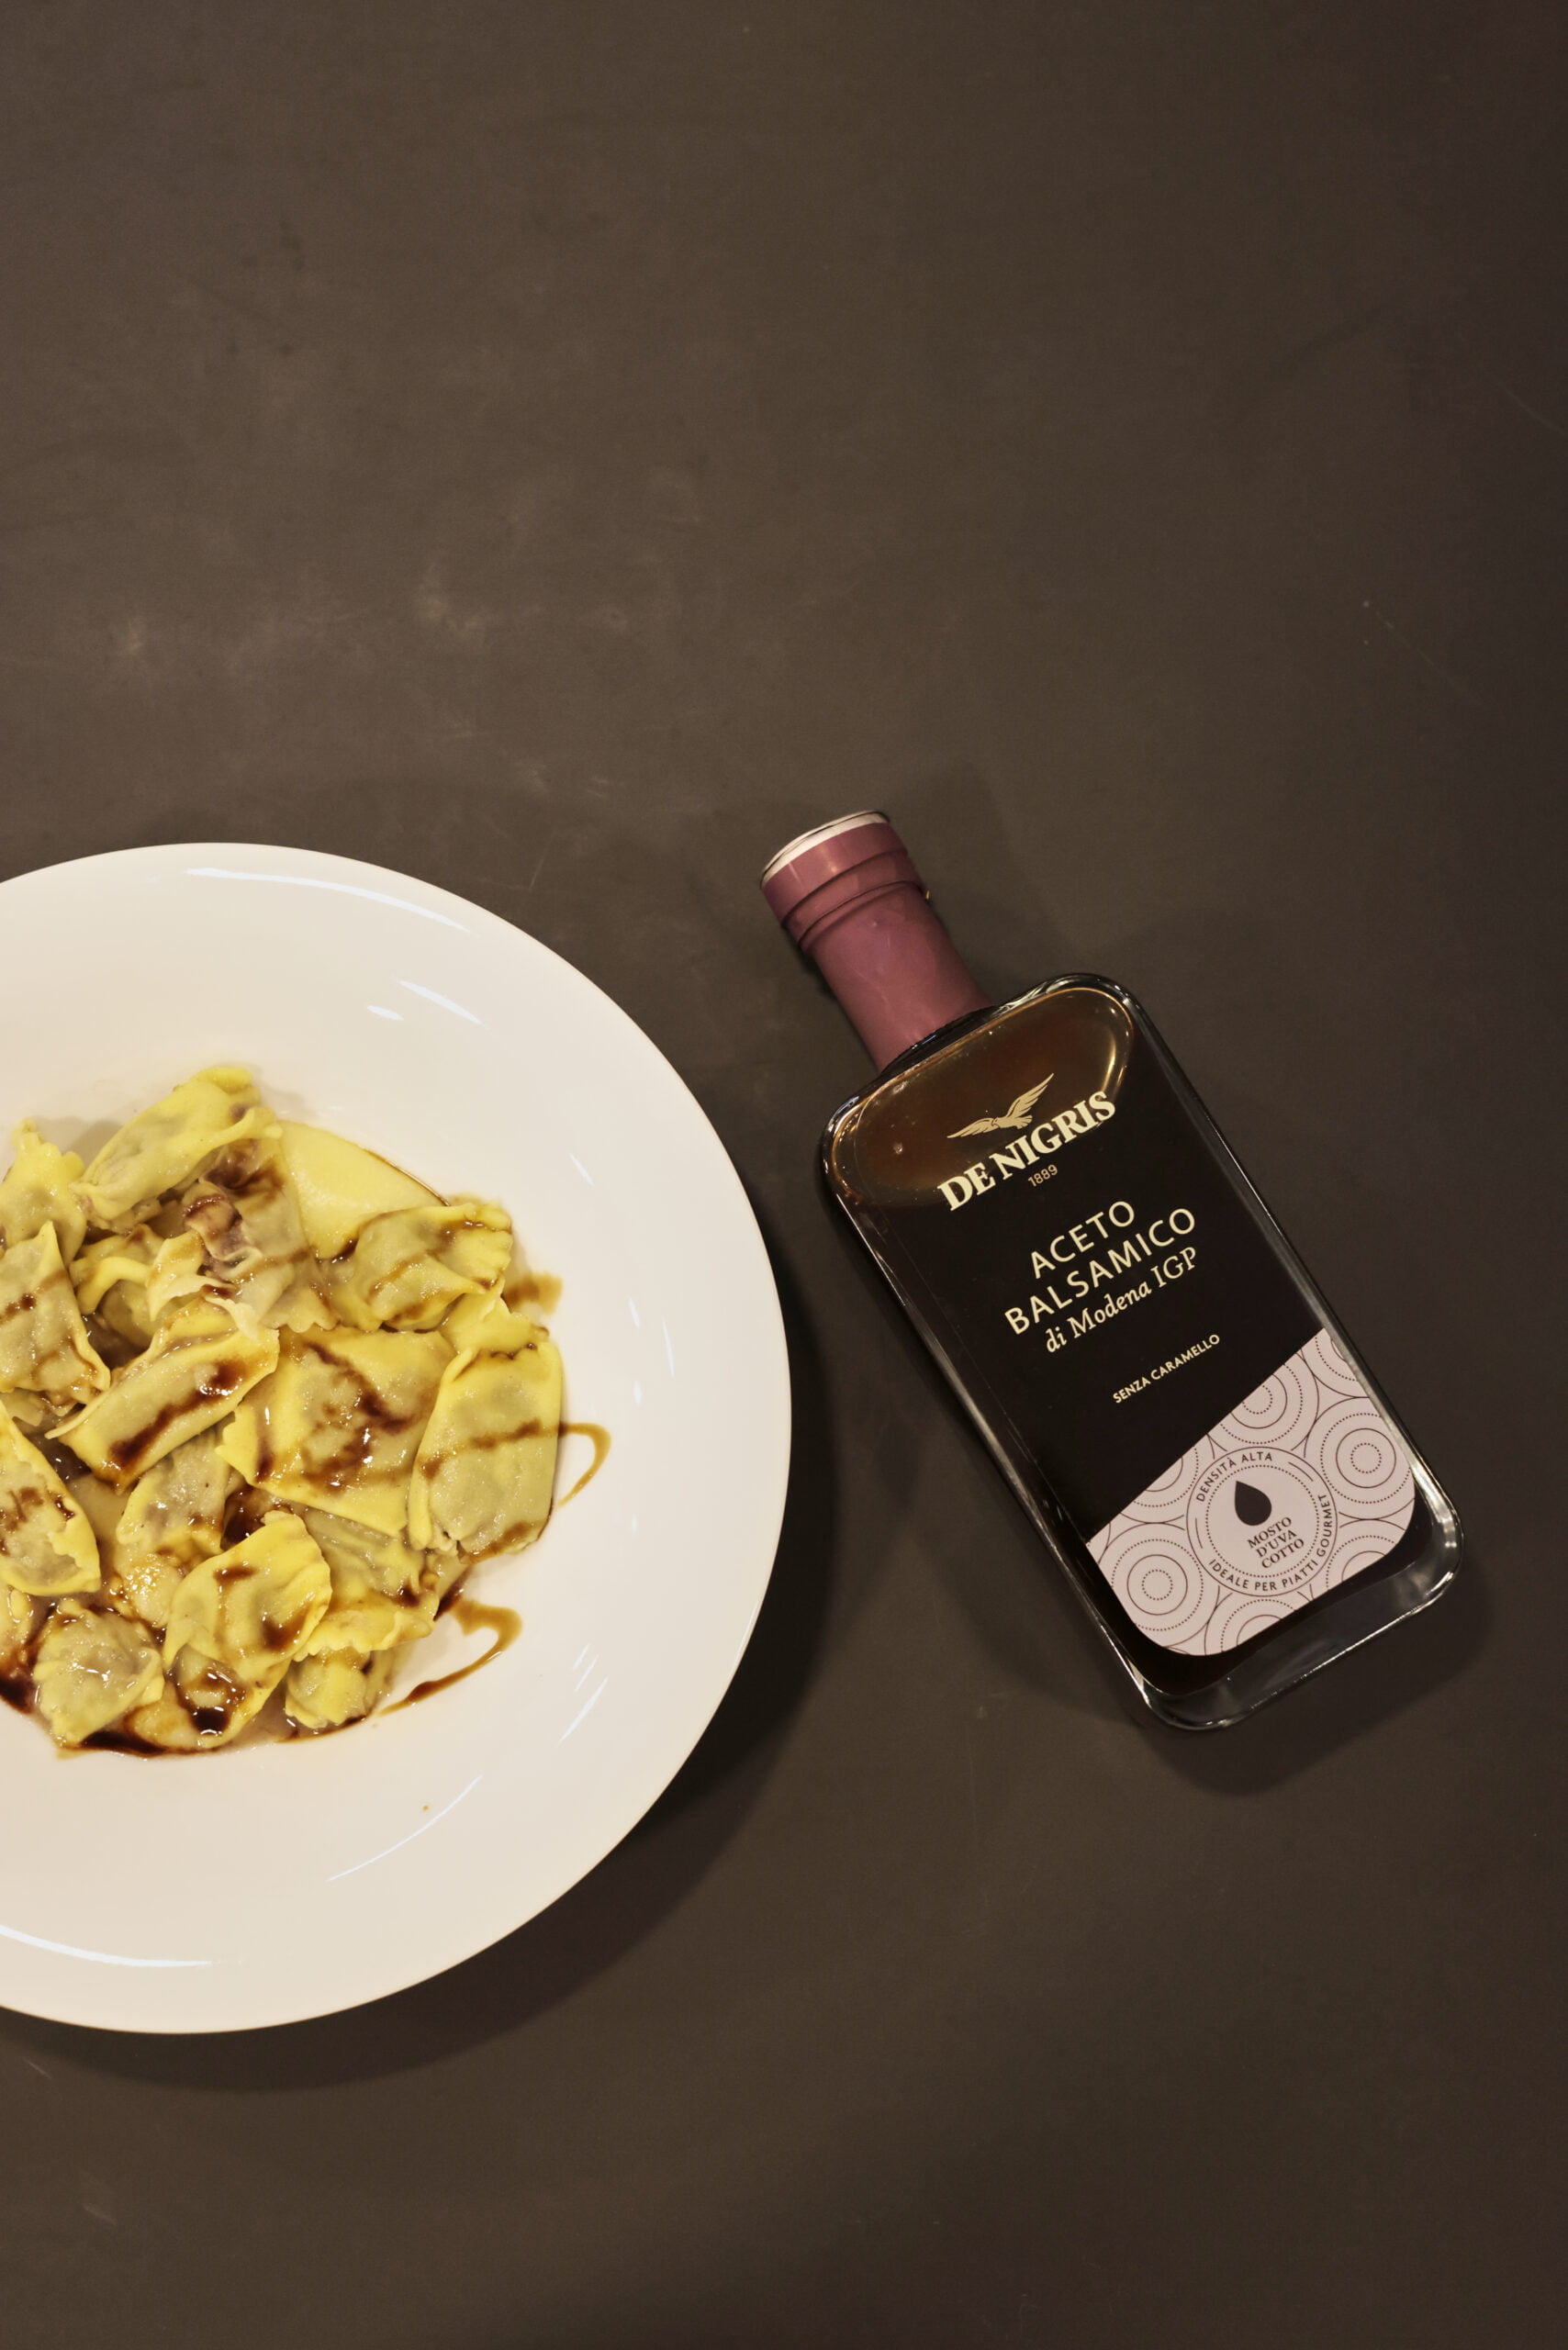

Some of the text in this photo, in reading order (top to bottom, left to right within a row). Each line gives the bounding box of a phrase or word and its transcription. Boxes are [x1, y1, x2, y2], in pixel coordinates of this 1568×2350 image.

[937, 1091, 1116, 1211] DE NIGRIS
[1027, 1164, 1058, 1188] 1889
[1004, 1208, 1195, 1335] BALSAMICO
[1029, 1201, 1135, 1279] ACETO
[1046, 1247, 1196, 1353] di Modena IGP
[1113, 1334, 1220, 1404] SENZA CARAMELLO
[1197, 1451, 1273, 1503] DENSITÀ ALTA
[1208, 1494, 1333, 1592] IDEALE PER PIATTI GOURMET
[1247, 1516, 1293, 1550] MOSTO
[1256, 1529, 1297, 1558] D'UVA
[1261, 1538, 1305, 1569] COTTO
